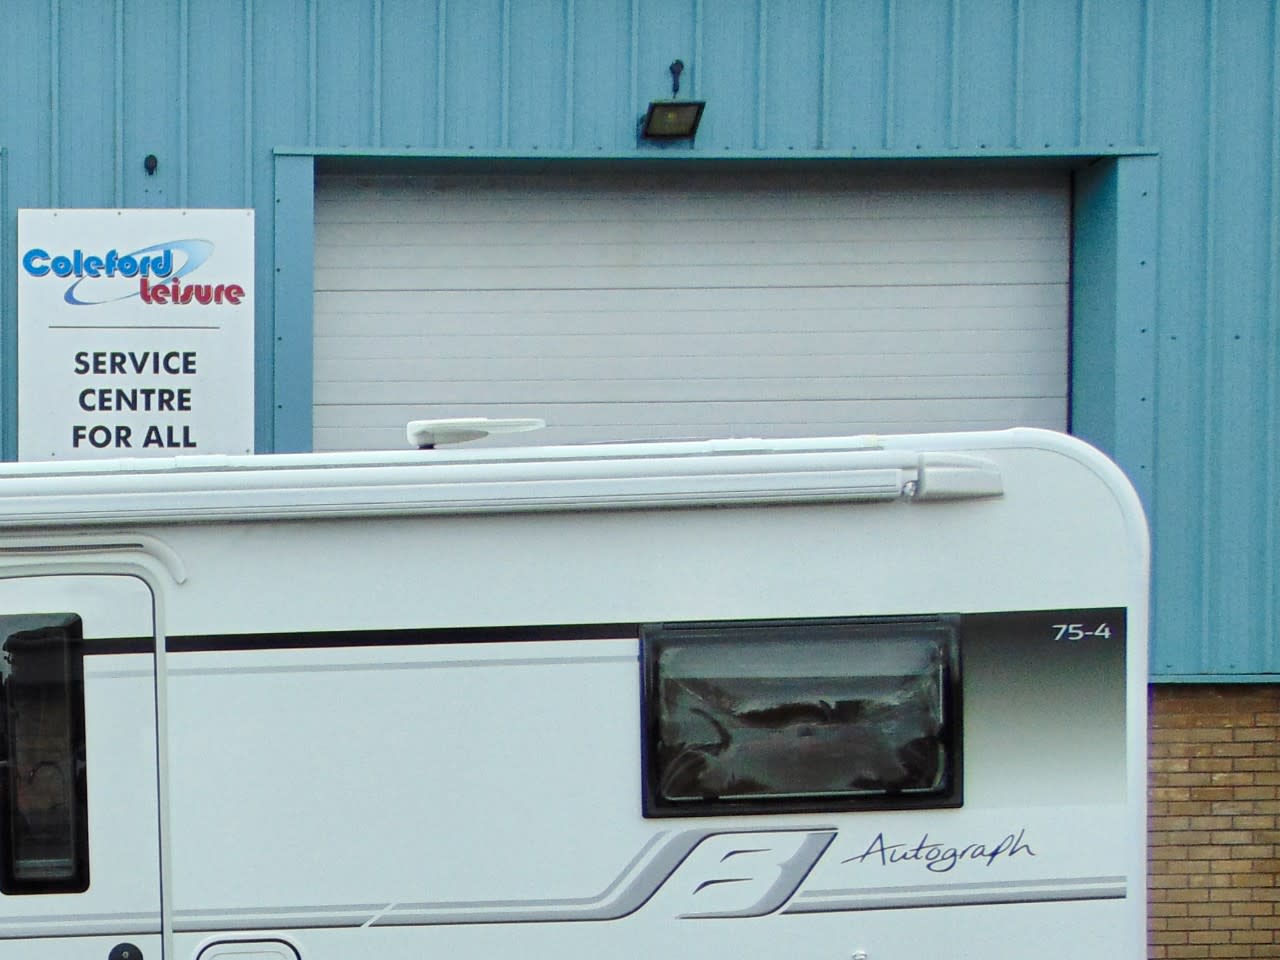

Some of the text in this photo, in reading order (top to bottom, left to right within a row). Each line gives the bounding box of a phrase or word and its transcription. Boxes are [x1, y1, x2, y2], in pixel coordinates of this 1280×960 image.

[23, 249, 173, 277] Coleford
[74, 351, 197, 375] SERVICE
[78, 388, 192, 412] CENTRE
[72, 425, 197, 449] FOR ALL
[1051, 623, 1111, 641] 75-4
[841, 829, 1036, 872] Autograph
